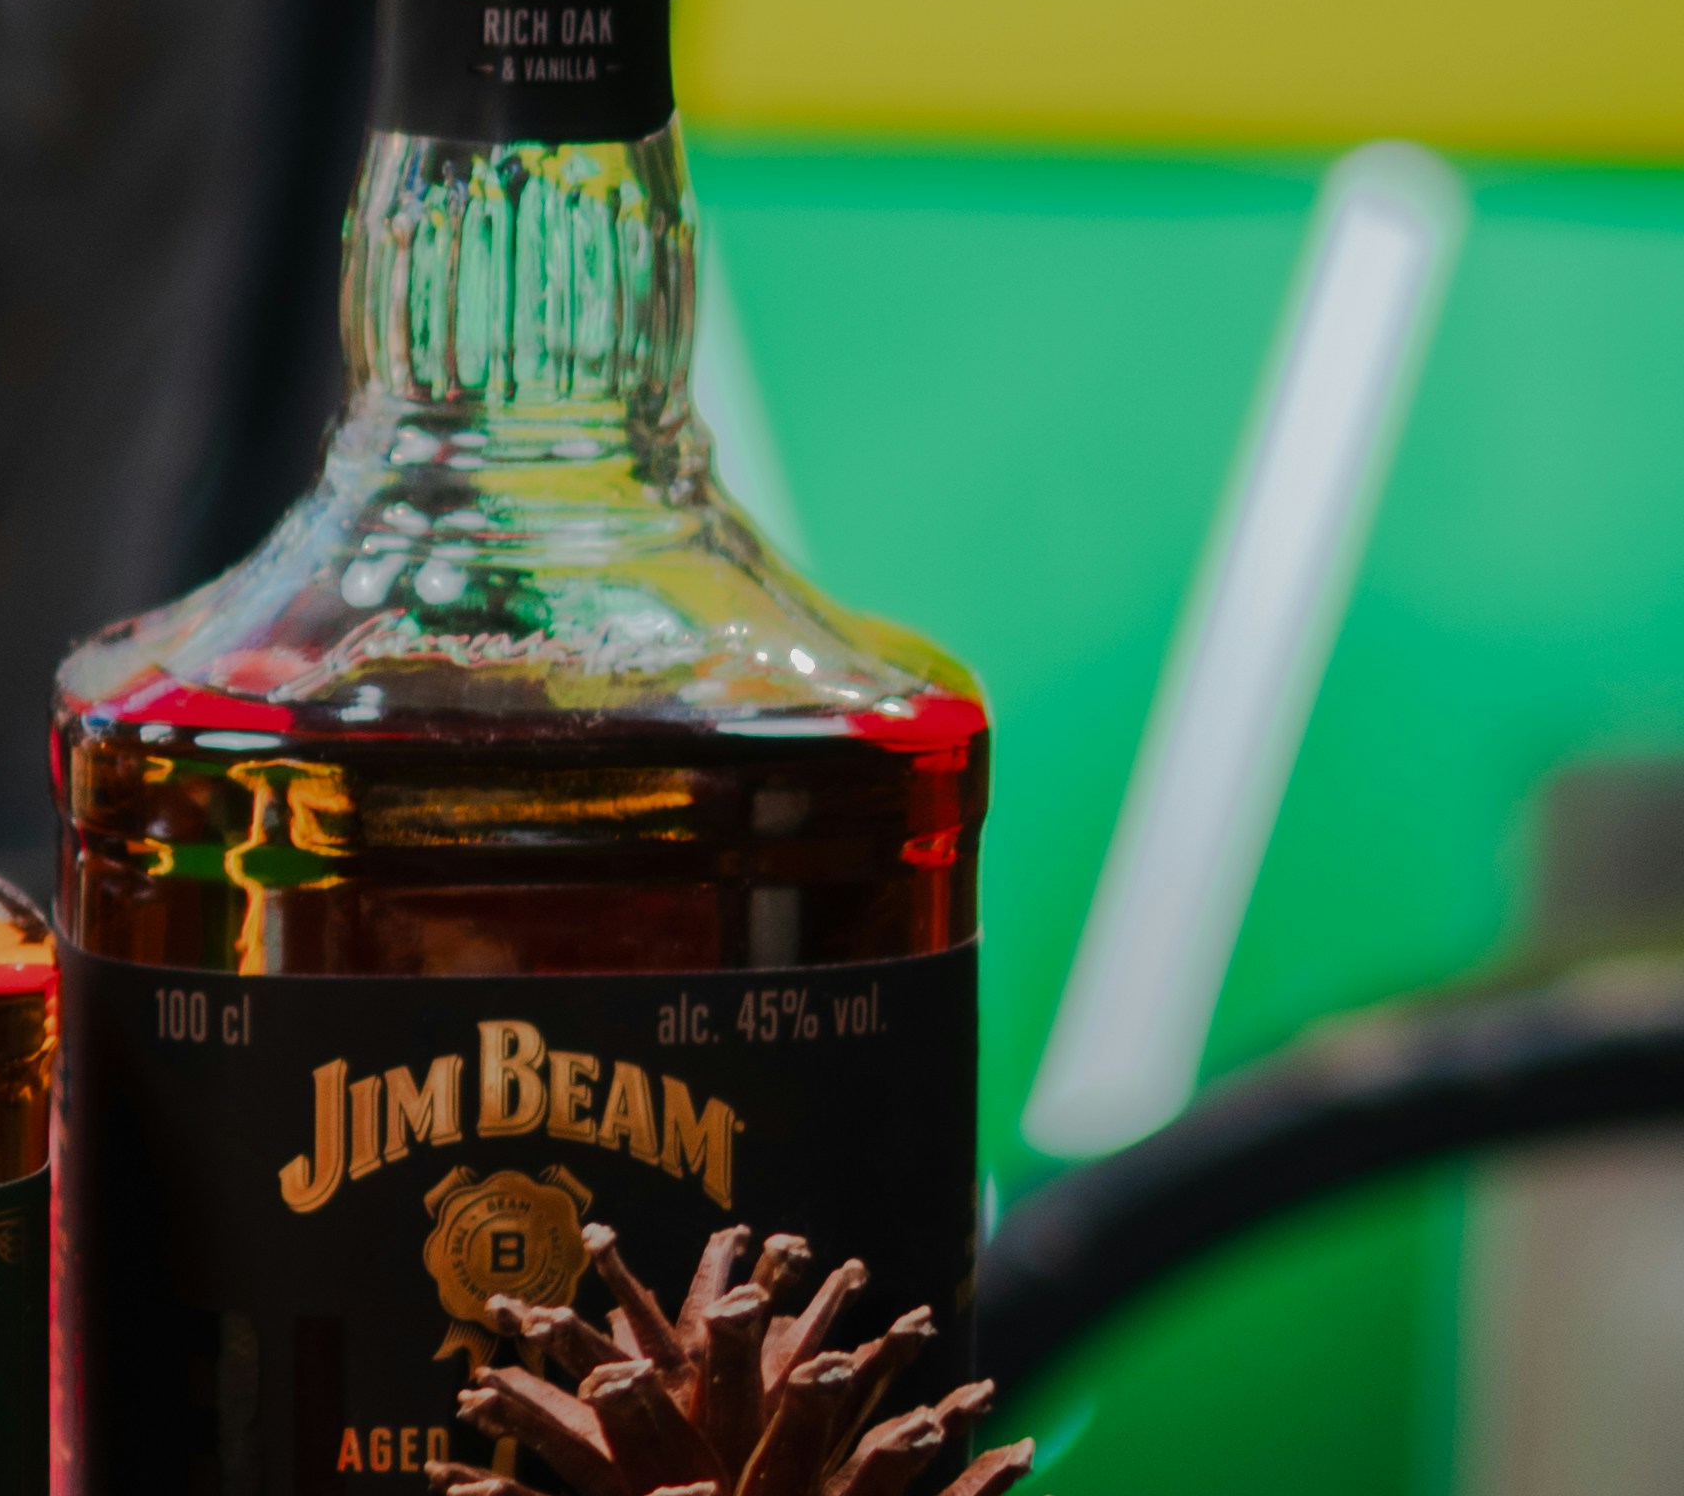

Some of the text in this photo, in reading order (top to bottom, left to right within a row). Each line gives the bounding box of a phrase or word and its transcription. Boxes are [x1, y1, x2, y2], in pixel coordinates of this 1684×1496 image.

[483, 8, 613, 45] RICH OAK
[524, 56, 597, 81] VANILLA
[155, 988, 251, 1045] 100 cl
[658, 983, 888, 1044] alc. 45% vol.
[278, 1019, 736, 1214] JIM BEAM
[490, 1231, 525, 1274] B
[336, 1427, 449, 1472] AGED
